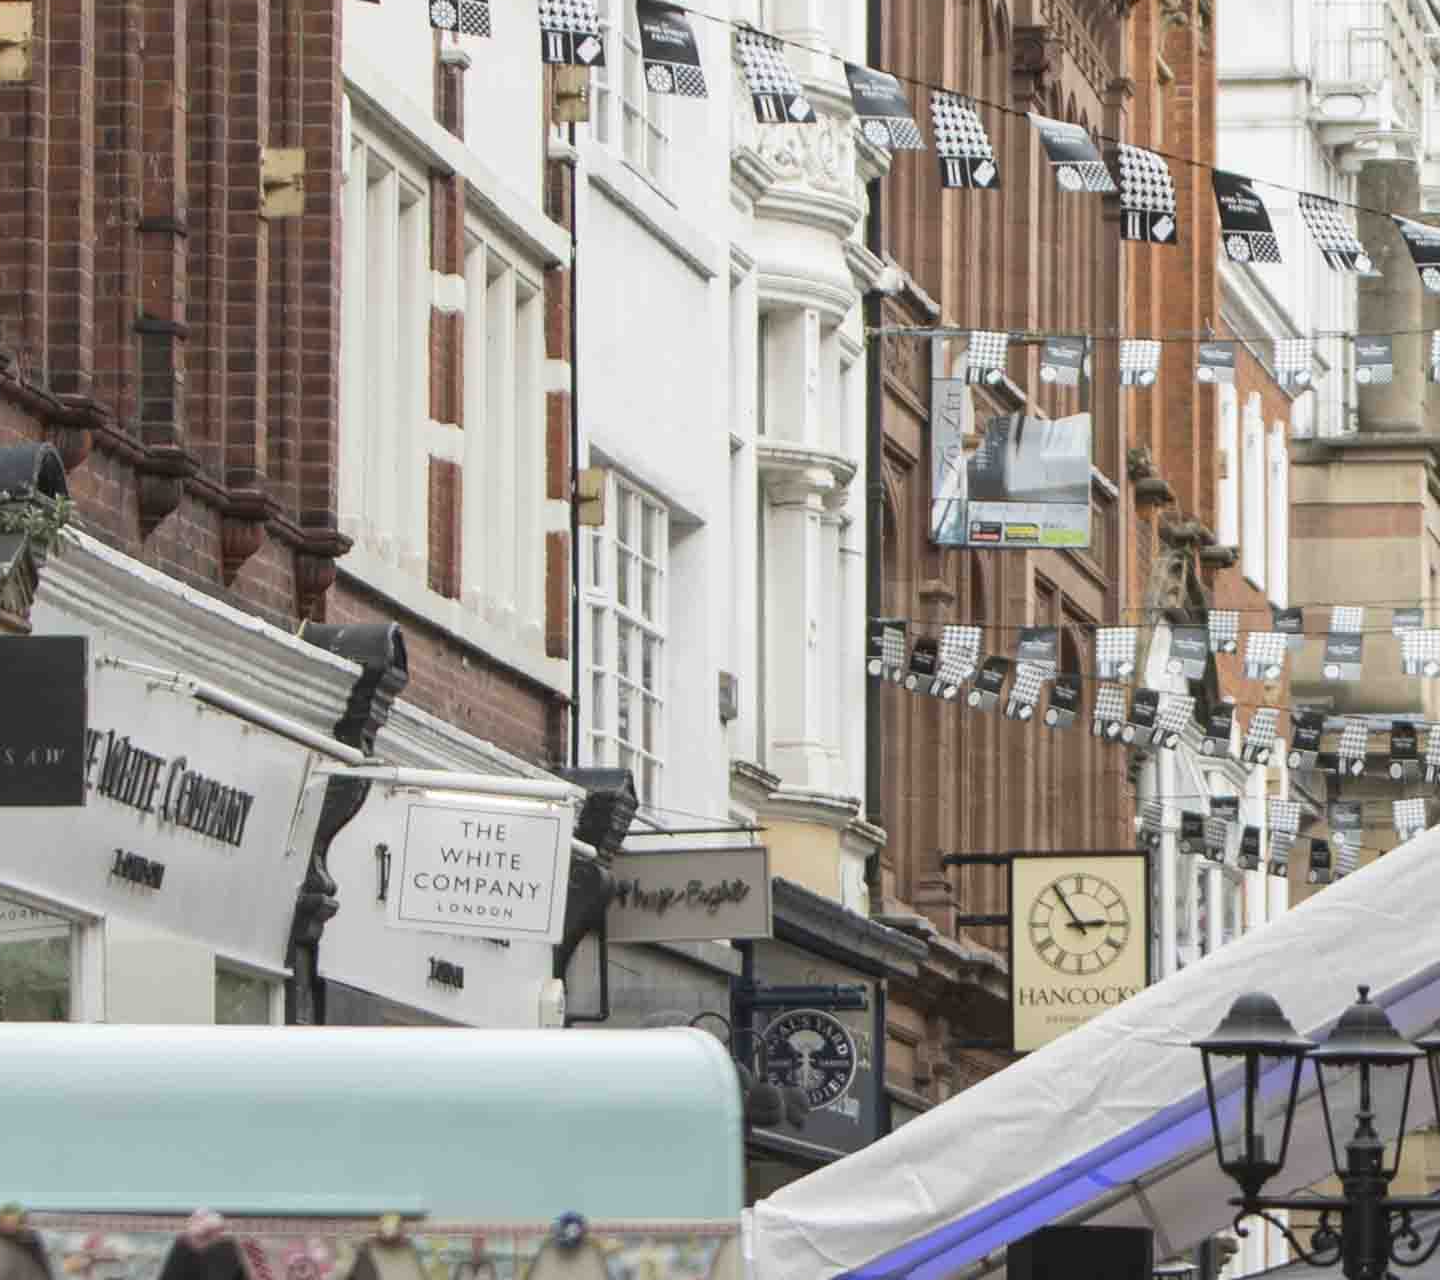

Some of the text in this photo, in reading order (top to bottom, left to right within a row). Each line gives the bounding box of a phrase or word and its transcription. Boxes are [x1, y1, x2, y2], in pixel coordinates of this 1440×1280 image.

[97, 730, 166, 814] WHITE
[162, 756, 255, 848] COMPANY
[460, 822, 507, 842] THE
[441, 848, 521, 871] WHITE
[414, 873, 542, 900] COMPANY
[437, 903, 514, 919] LONDON
